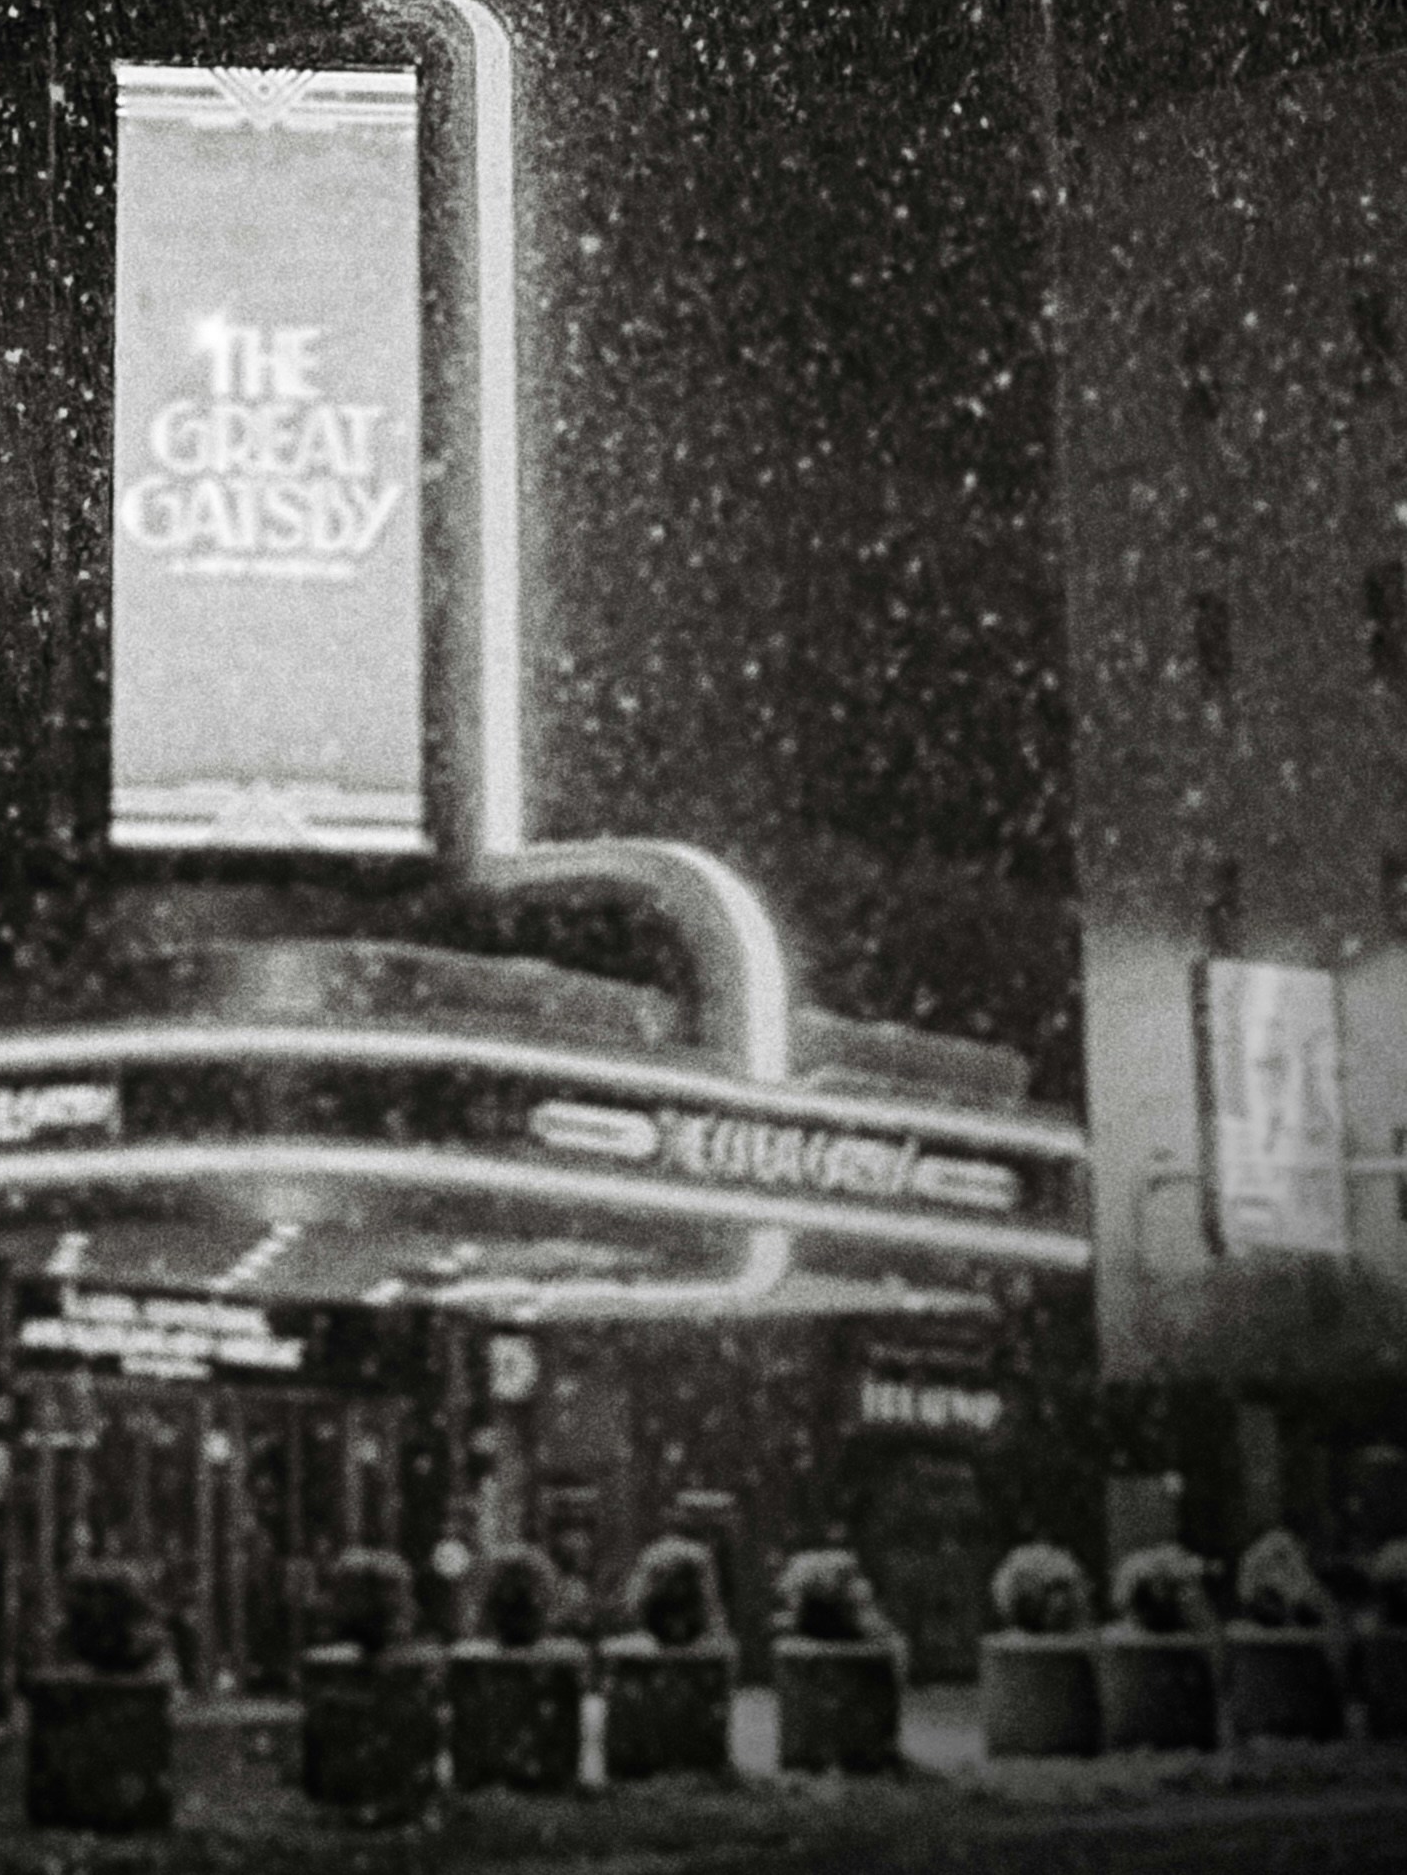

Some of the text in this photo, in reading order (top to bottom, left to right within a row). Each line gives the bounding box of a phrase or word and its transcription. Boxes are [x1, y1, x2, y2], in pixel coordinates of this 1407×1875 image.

[195, 312, 322, 399] THE
[150, 404, 382, 475] GREAT
[117, 477, 403, 554] GATSBY
